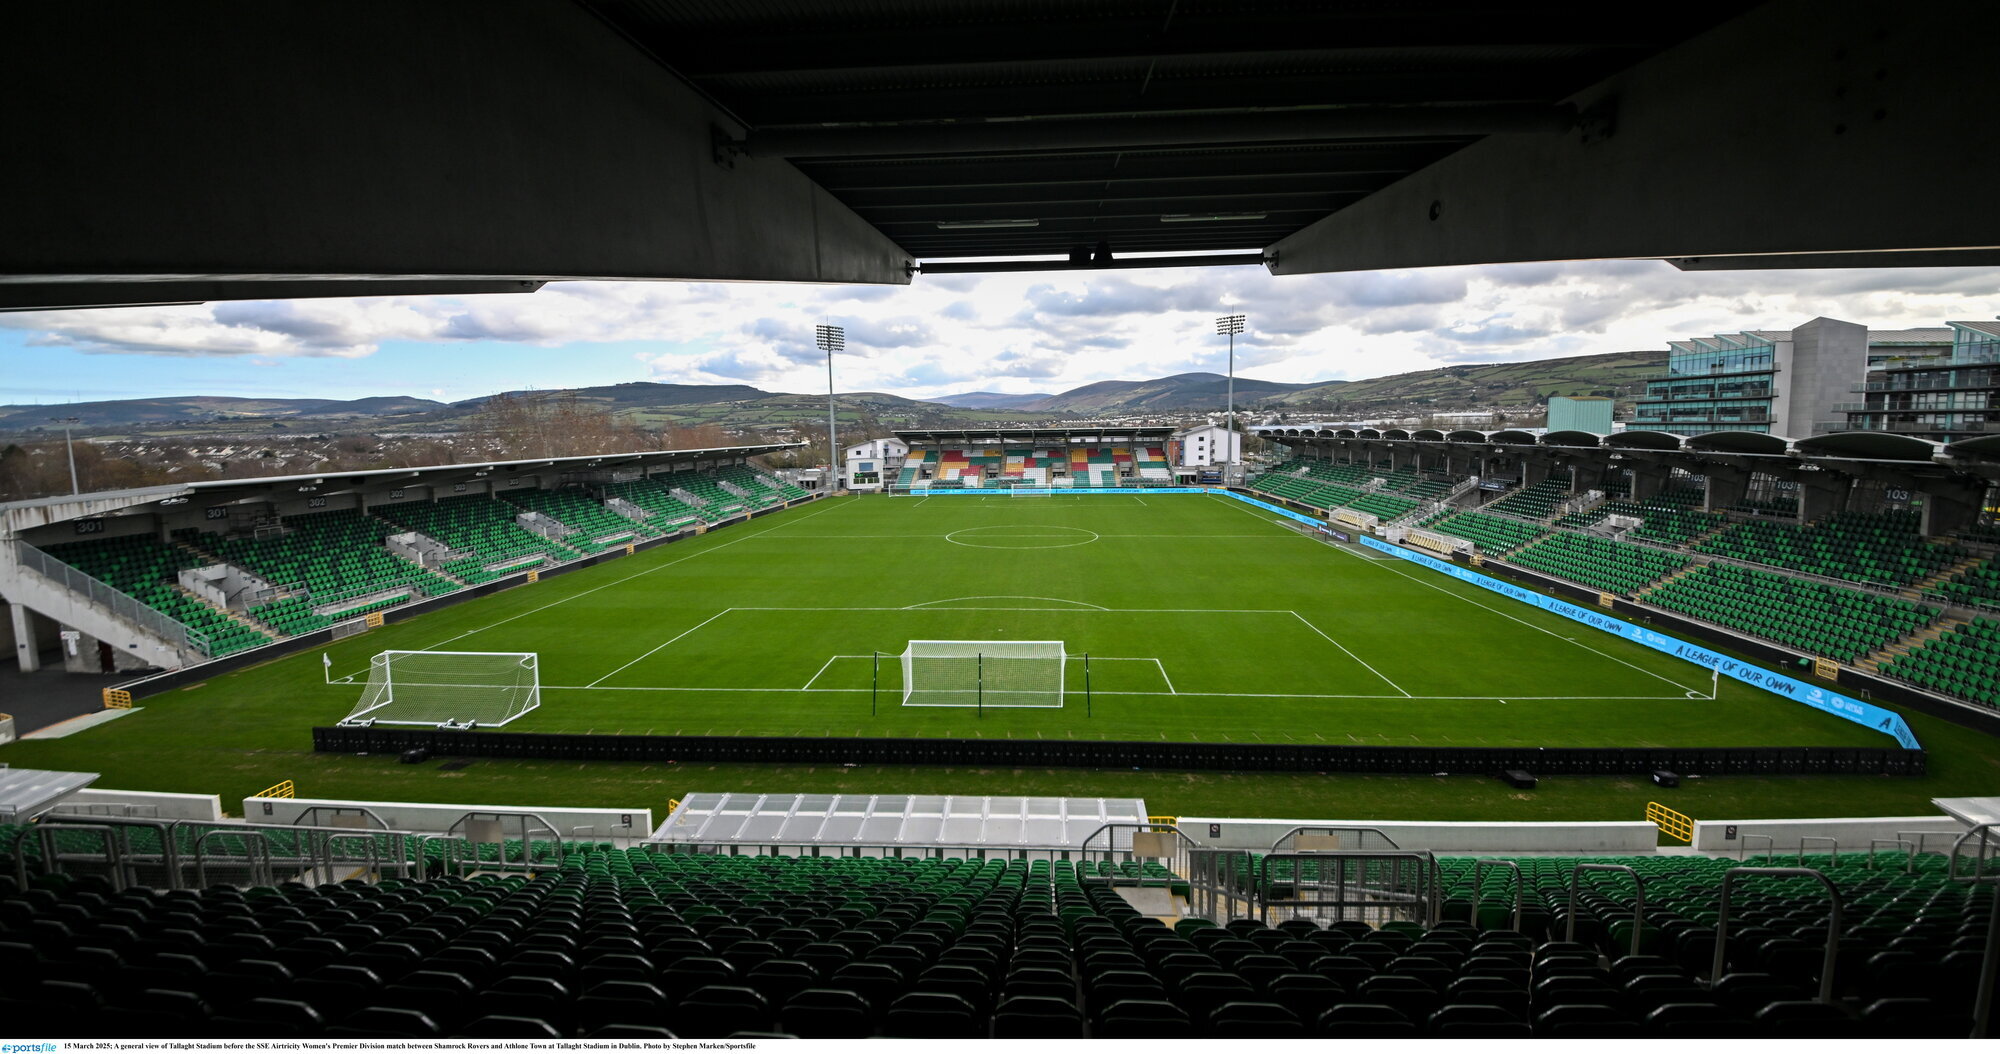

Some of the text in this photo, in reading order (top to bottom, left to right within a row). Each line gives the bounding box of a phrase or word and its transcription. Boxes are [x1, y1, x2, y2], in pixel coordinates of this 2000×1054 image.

[1691, 474, 1705, 482] 103
[1776, 480, 1794, 490] 103
[390, 490, 404, 498] 302
[1886, 489, 1908, 500] 103
[309, 498, 325, 507] 302
[207, 508, 227, 518] 301
[77, 521, 103, 533] 301
[1554, 603, 1577, 617] LEAGUE
[1577, 610, 1588, 619] OF
[1588, 614, 1603, 626] OUR
[1603, 620, 1623, 632] OWN
[1675, 645, 1797, 695] A LEAGUE OF OUR OWN
[1878, 716, 1892, 730] A
